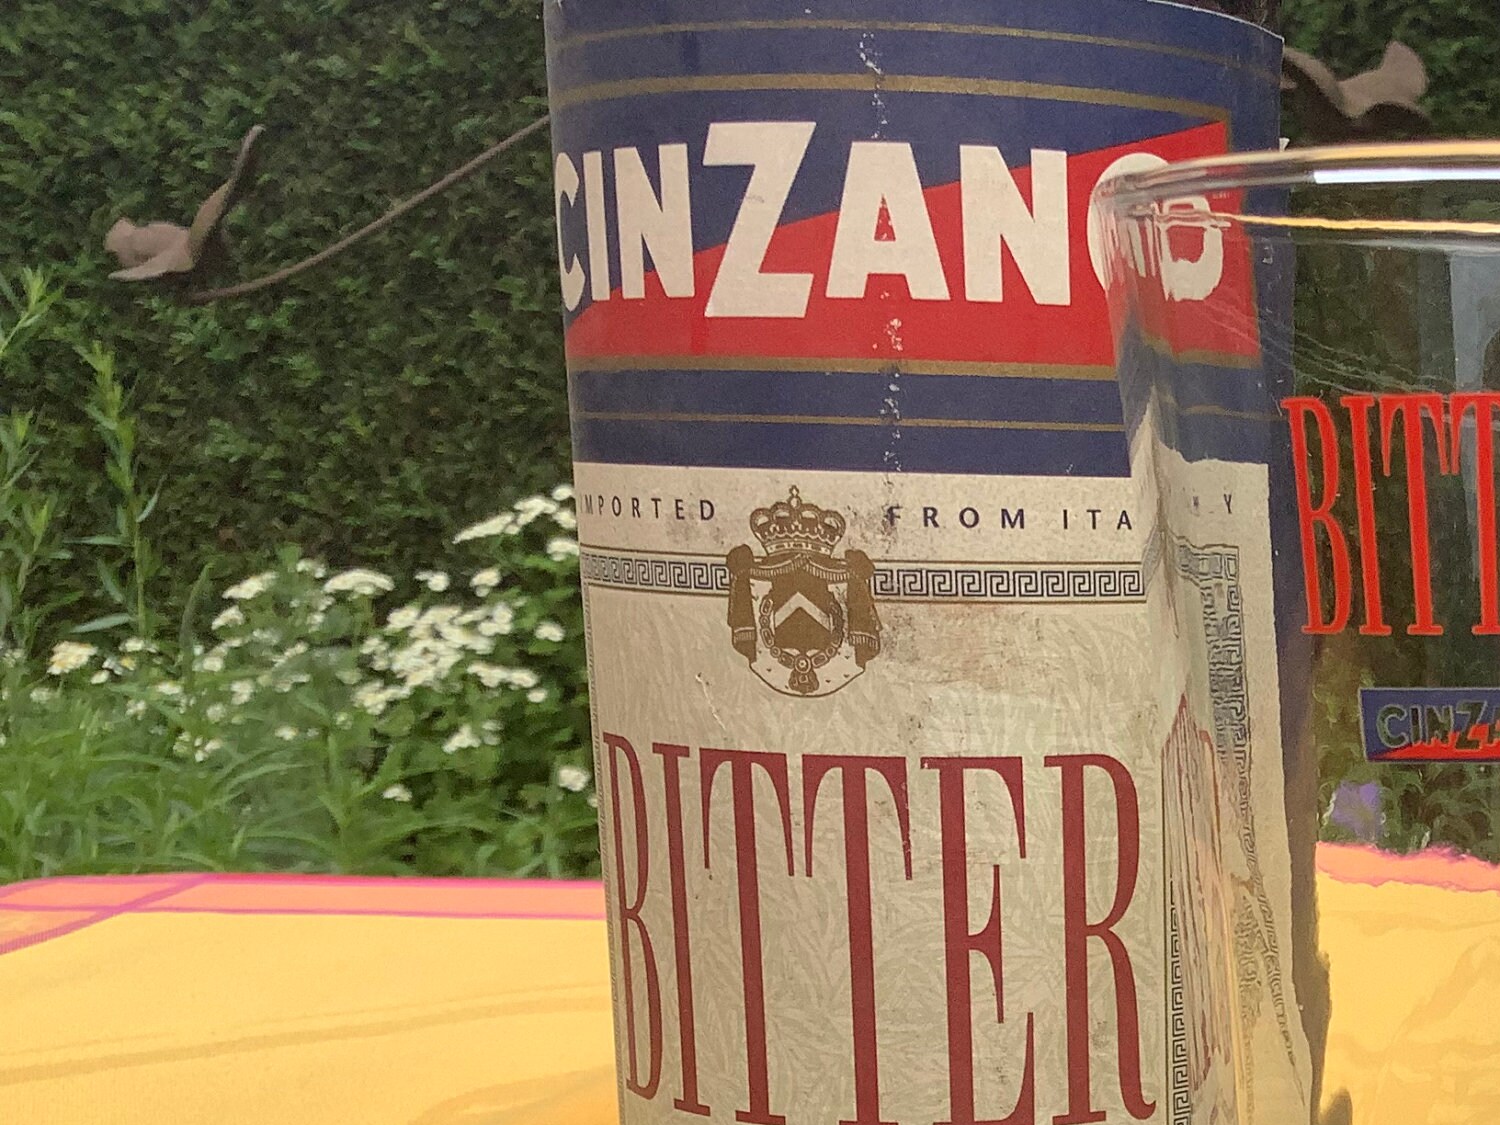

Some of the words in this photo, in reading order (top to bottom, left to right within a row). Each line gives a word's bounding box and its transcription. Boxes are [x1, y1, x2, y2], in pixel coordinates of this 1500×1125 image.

[555, 121, 1223, 317] CINZANO
[580, 494, 715, 521] IMPORTED
[886, 506, 1025, 529] FROM
